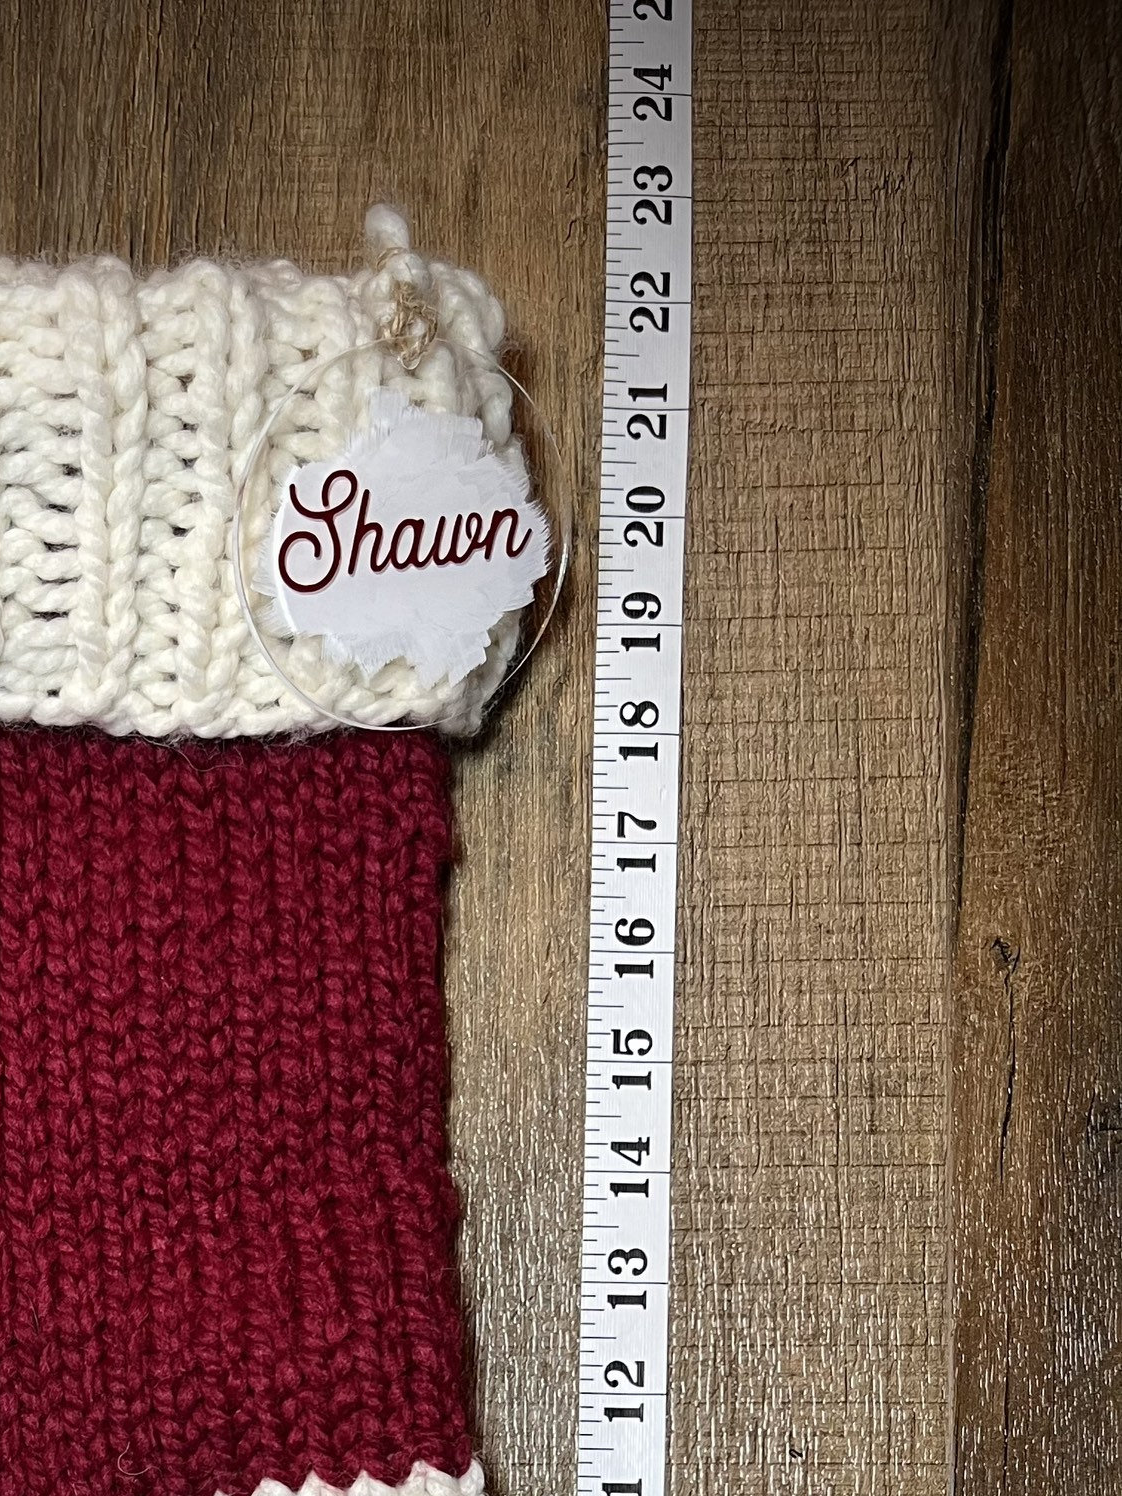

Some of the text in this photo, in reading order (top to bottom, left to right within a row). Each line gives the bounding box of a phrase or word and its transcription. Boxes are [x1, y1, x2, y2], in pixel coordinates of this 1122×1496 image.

[632, 63, 673, 122] 24
[632, 165, 673, 226] 23
[629, 271, 671, 333] 22
[626, 383, 668, 440] 21
[278, 469, 533, 594] Shawn
[623, 485, 666, 548] 20
[621, 591, 662, 652] 19
[619, 700, 659, 761] 18
[616, 811, 657, 873] 17
[614, 918, 655, 979] 16
[611, 1029, 653, 1090] 15
[609, 1136, 650, 1198] 14
[607, 1248, 648, 1310] 13
[603, 1360, 645, 1423] 12
